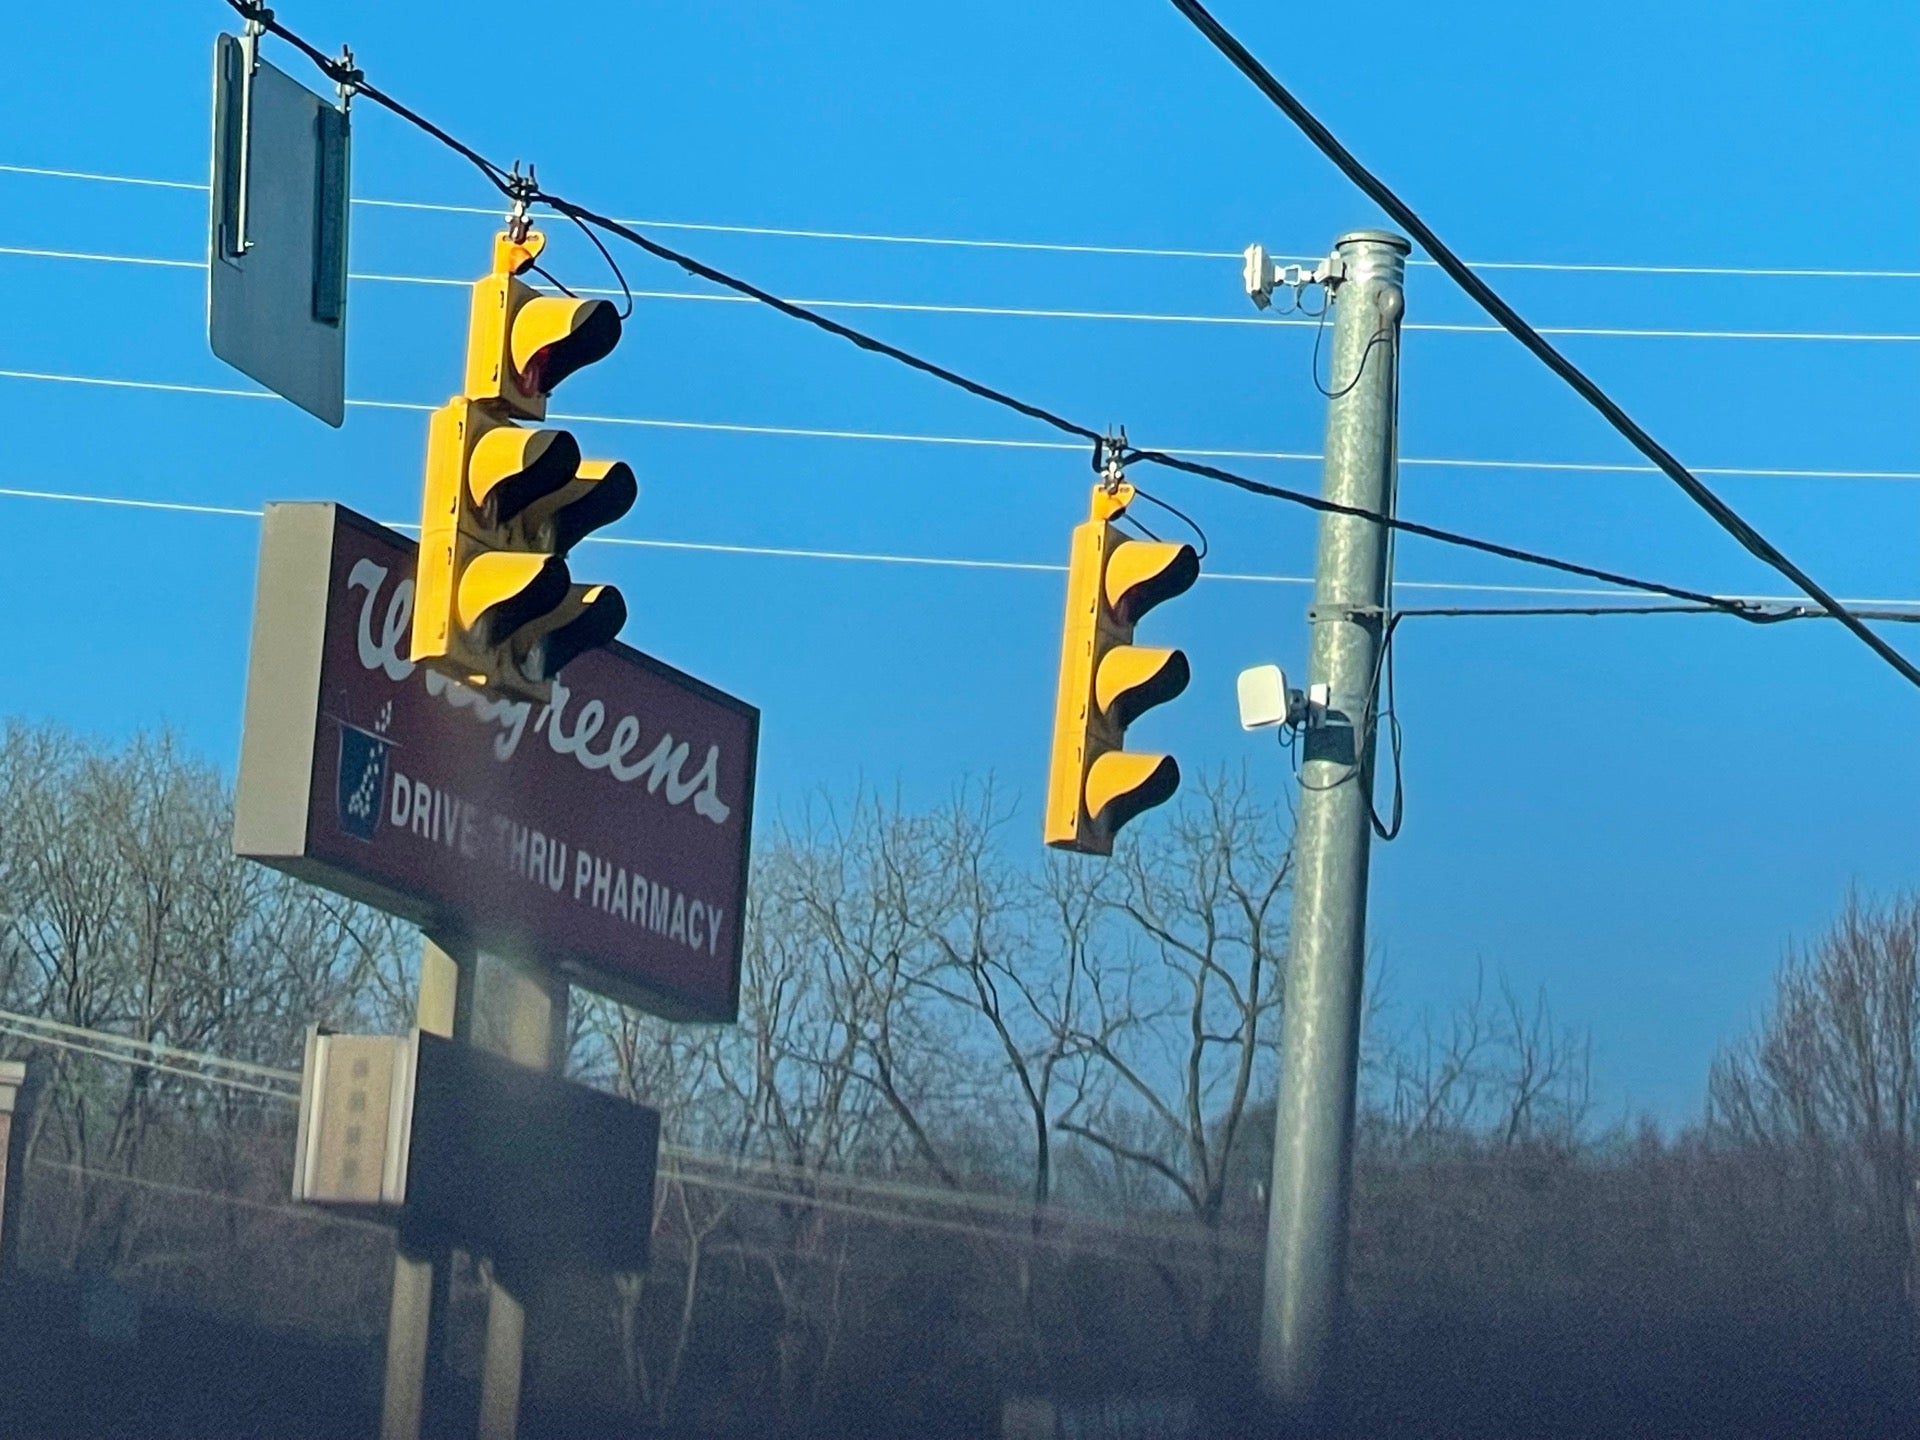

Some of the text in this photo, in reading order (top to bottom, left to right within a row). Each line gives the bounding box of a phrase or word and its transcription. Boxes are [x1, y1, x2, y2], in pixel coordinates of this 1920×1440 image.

[348, 558, 730, 824] Wgreens
[391, 772, 476, 859] DRIVE
[574, 850, 723, 956] PHARMACY
